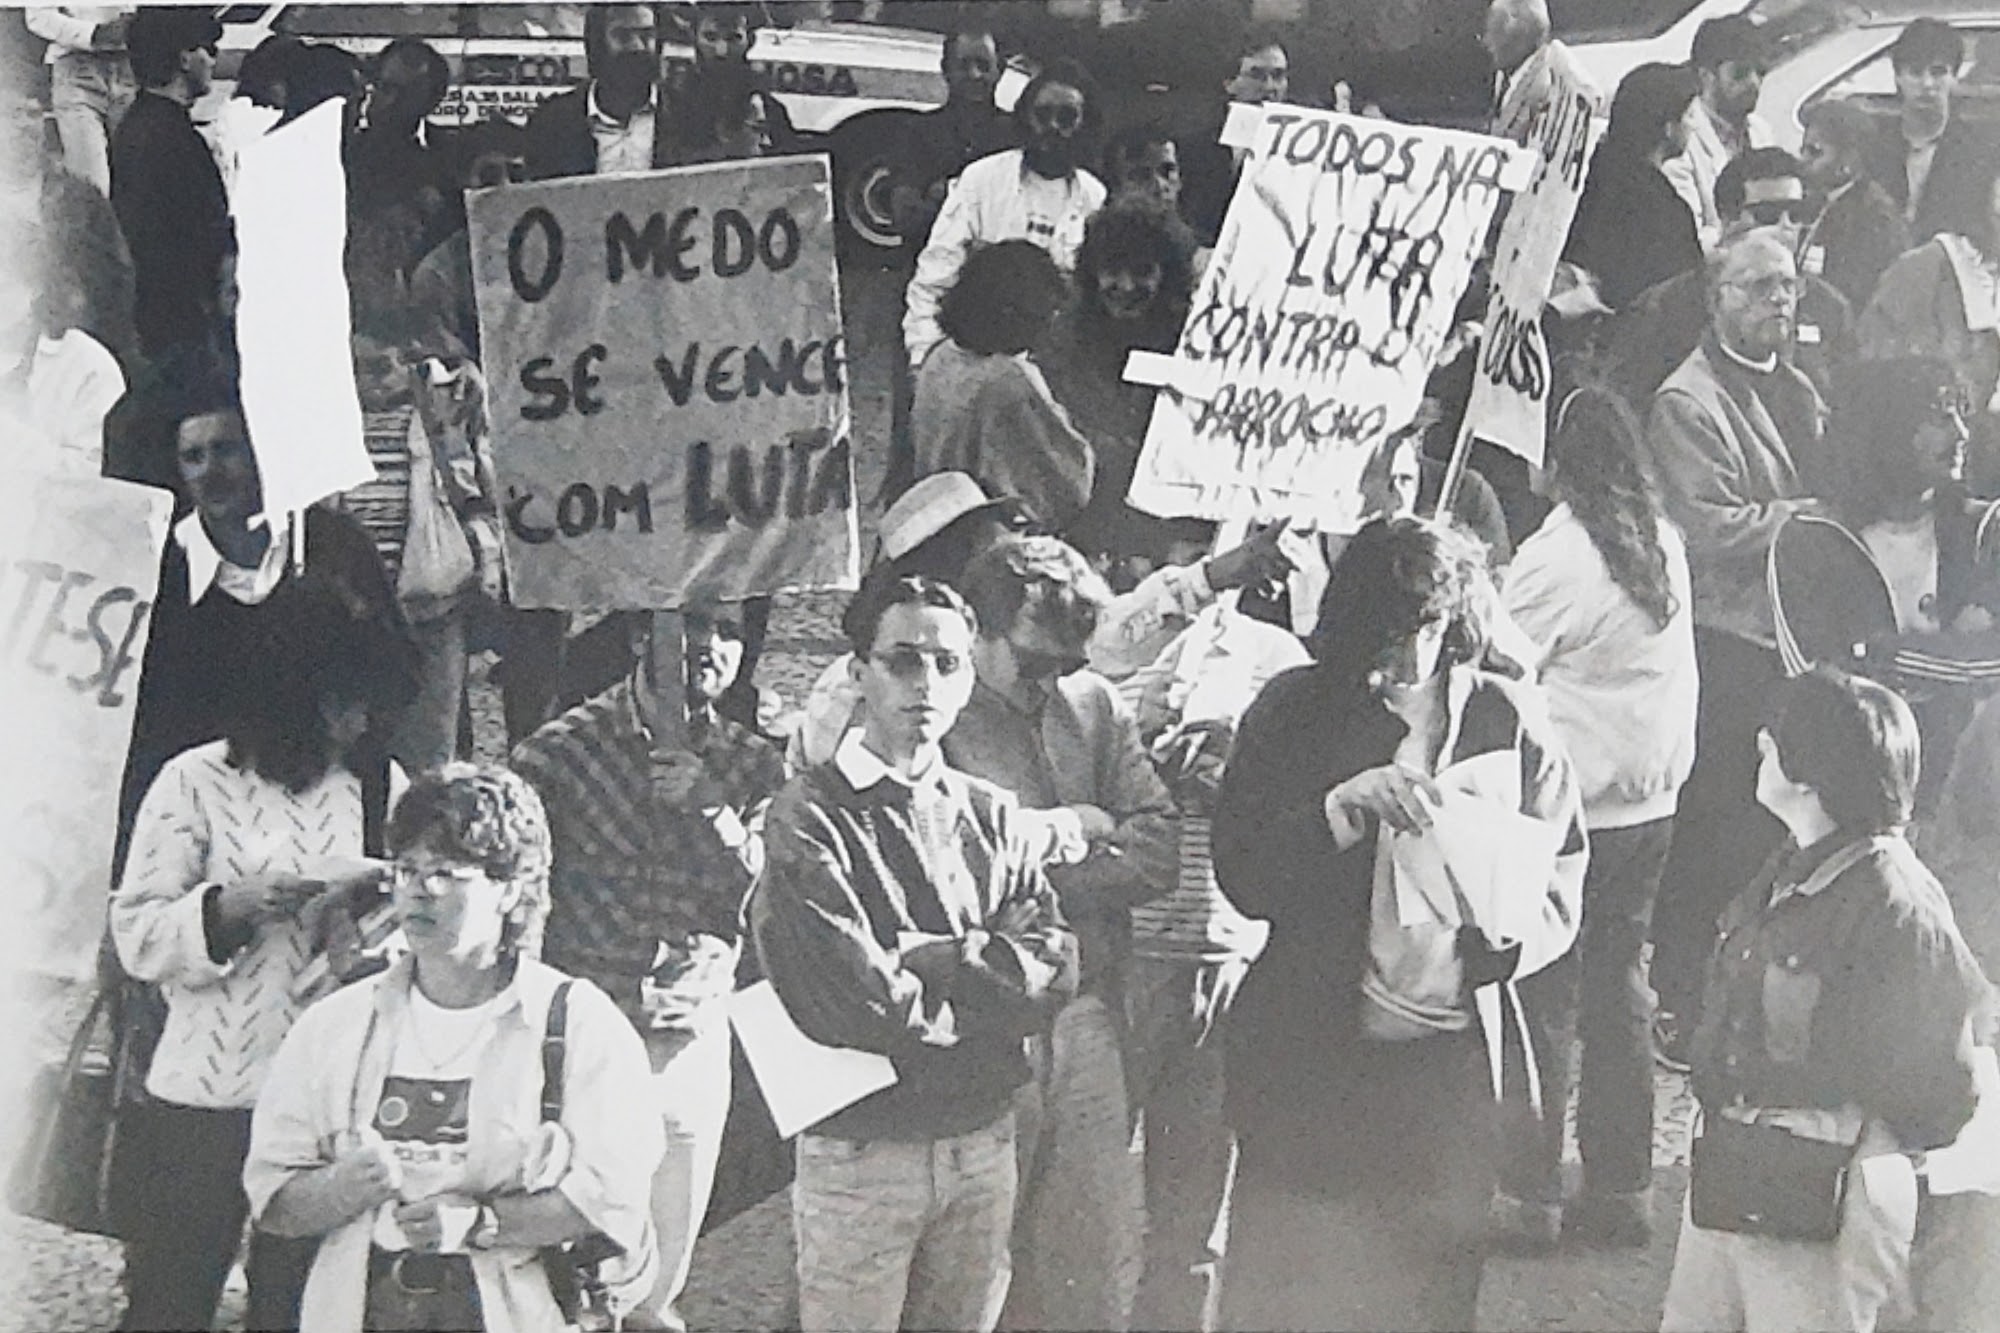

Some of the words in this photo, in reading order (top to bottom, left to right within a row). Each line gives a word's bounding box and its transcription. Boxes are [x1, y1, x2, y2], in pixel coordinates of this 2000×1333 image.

[1267, 115, 1423, 184] TODOS
[1433, 145, 1510, 206] NA
[508, 206, 564, 303] O
[605, 206, 801, 284] MEDO
[1286, 220, 1444, 305] LUTA
[519, 343, 607, 421] SE
[654, 333, 849, 406] VENCE
[1184, 304, 1360, 374] CONTRA
[504, 480, 654, 544] COM
